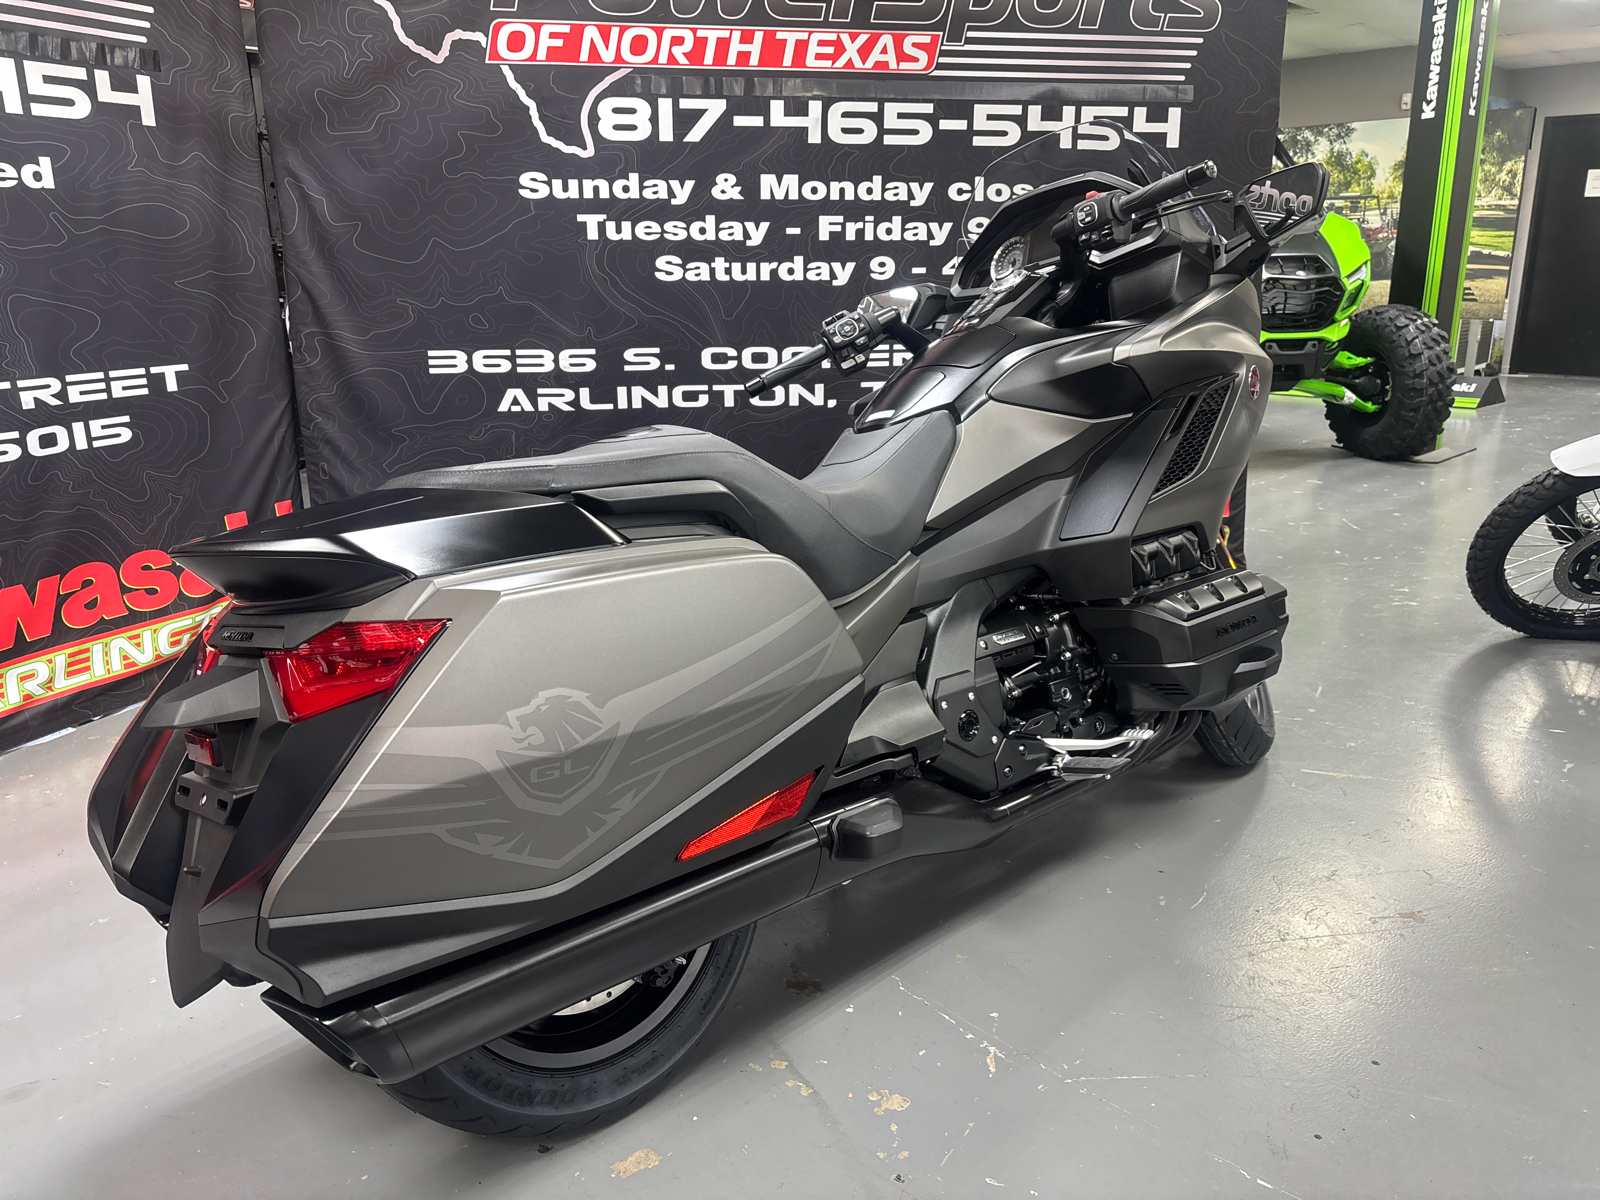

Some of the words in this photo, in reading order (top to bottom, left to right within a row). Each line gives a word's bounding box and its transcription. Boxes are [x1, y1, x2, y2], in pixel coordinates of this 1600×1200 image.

[496, 22, 571, 61] OF
[579, 25, 763, 66] NORTH
[775, 31, 932, 70] TEXAS
[597, 97, 1182, 151] 817-465-5454
[517, 171, 696, 206] Sunday
[710, 172, 745, 201] &
[759, 173, 935, 207] Monday
[947, 175, 1035, 203] clos
[576, 213, 771, 247] Tuesday
[785, 227, 802, 235] -
[818, 215, 954, 247] Friday
[654, 254, 857, 287] Saturday
[869, 255, 896, 281] 9
[911, 266, 927, 274] -
[427, 348, 597, 375] 3636
[623, 347, 676, 372] S.
[700, 344, 915, 371] COER
[0, 363, 190, 410] REET
[497, 383, 837, 412] ARLINGTON,
[0, 605, 223, 707] RLINGT
[530, 759, 591, 784] GL
